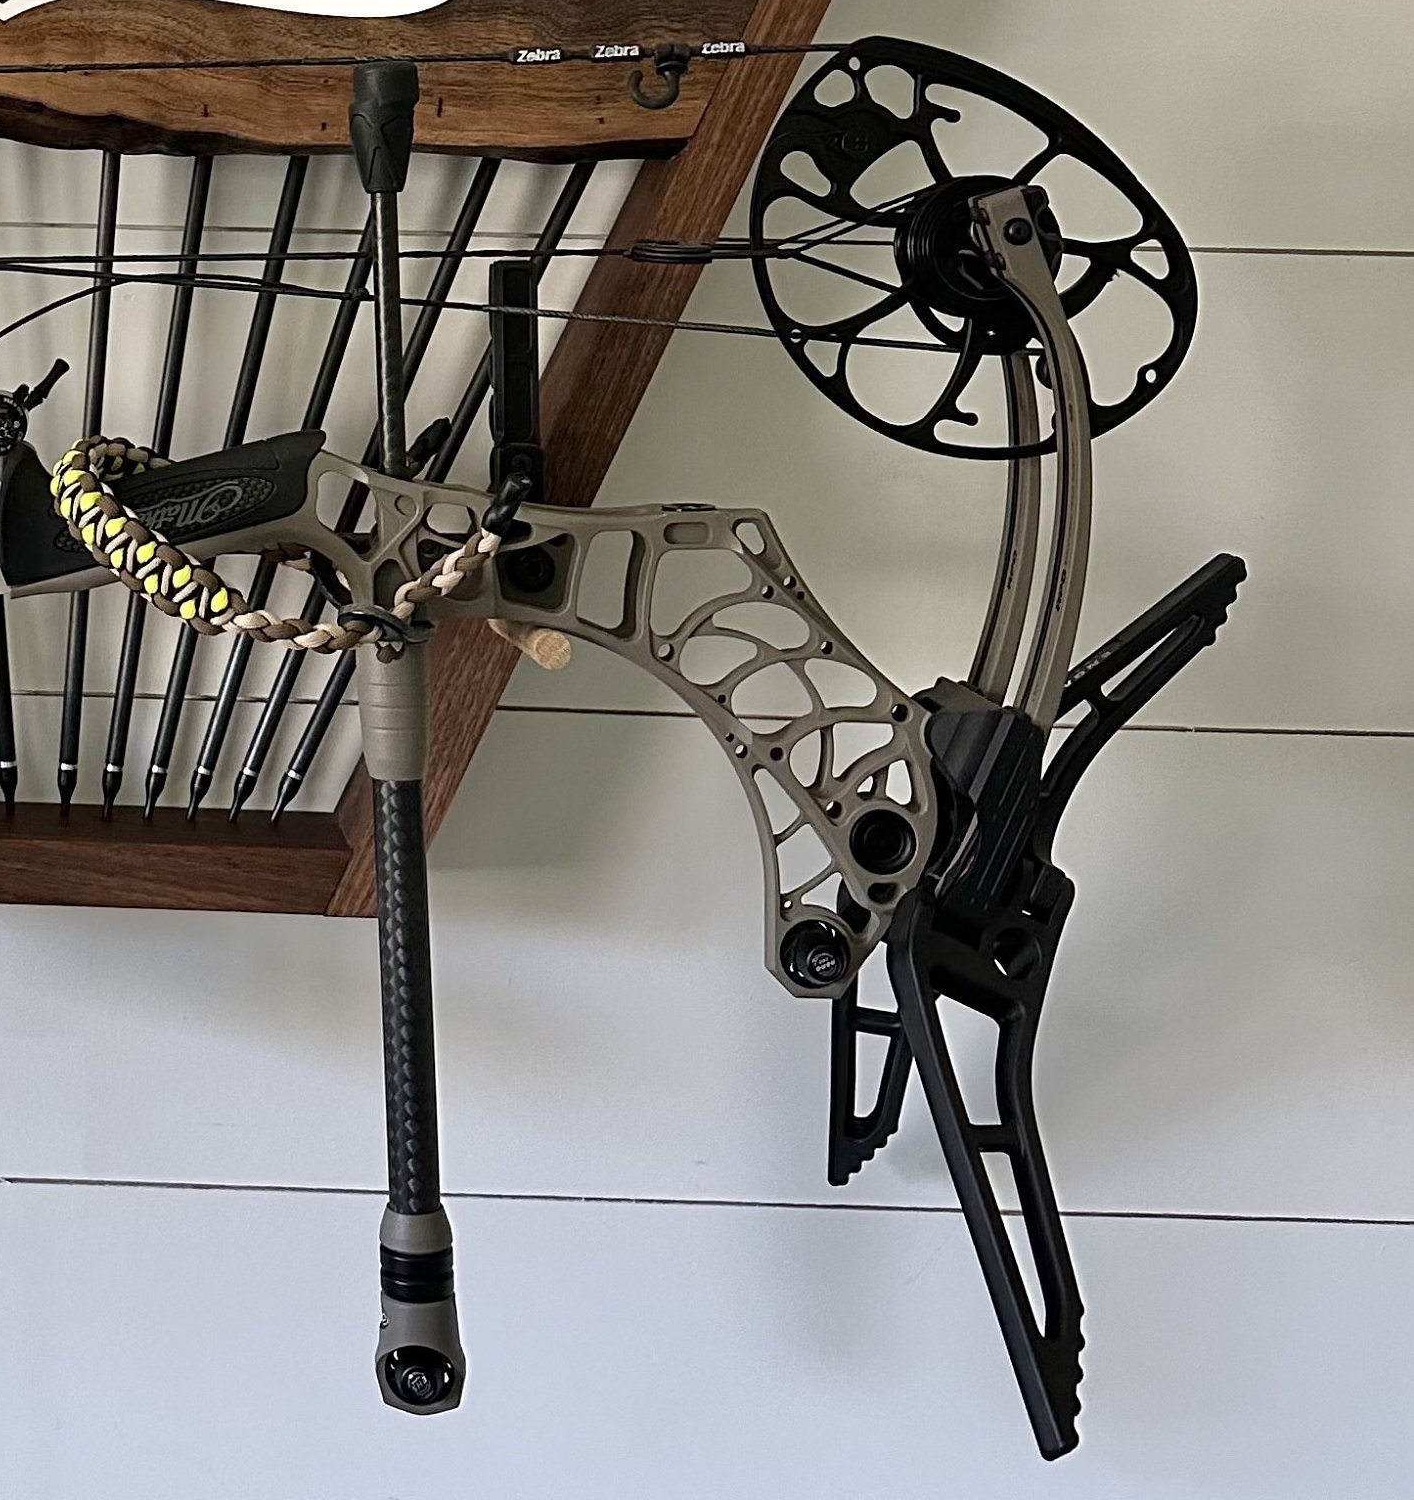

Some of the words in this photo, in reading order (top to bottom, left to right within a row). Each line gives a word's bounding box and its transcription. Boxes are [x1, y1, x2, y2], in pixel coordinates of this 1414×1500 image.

[516, 47, 561, 63] Zebra
[595, 44, 640, 60] Zebra
[136, 480, 243, 531] Mathe
